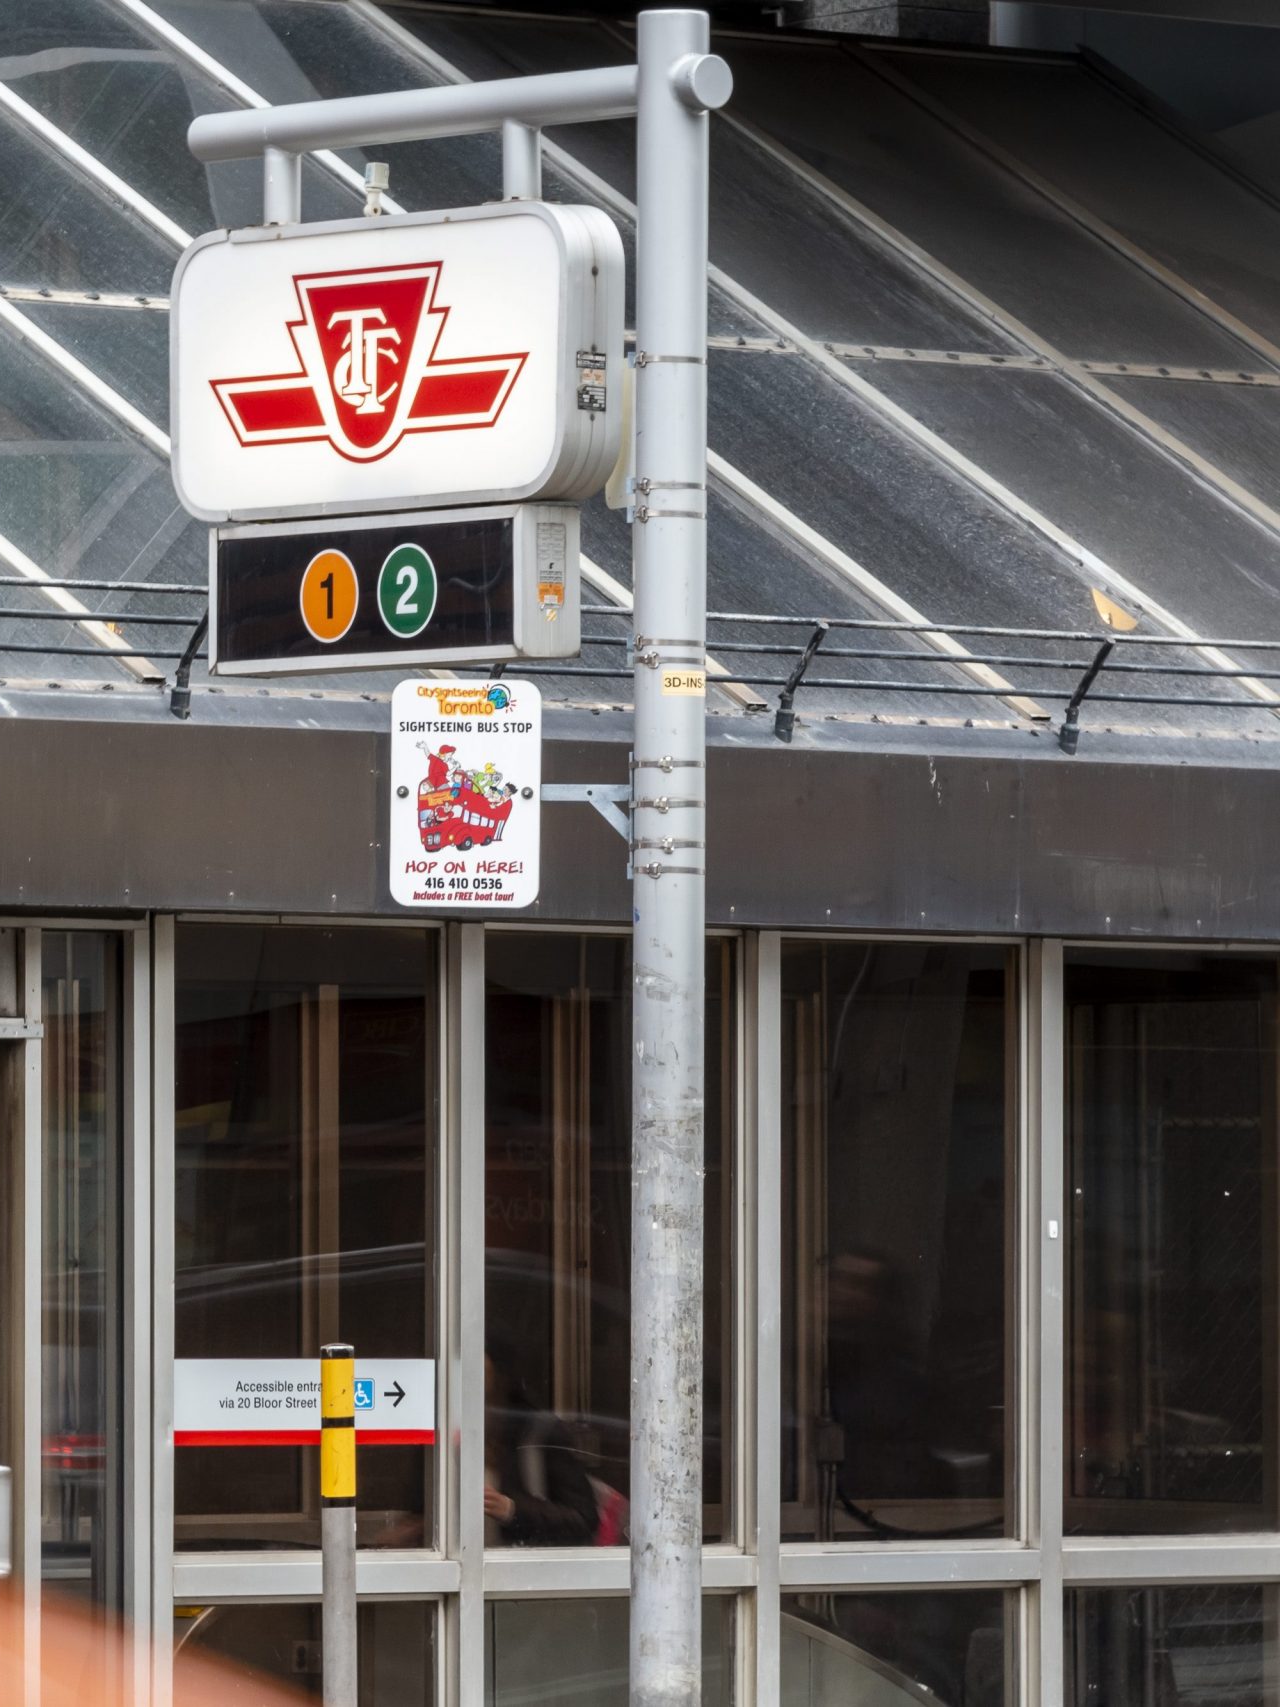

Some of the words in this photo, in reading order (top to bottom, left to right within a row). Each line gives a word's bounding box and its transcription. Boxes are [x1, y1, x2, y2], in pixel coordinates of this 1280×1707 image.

[326, 307, 402, 415] TTC
[320, 572, 334, 620] 1
[395, 565, 419, 615] 2
[439, 699, 494, 714] Toronto
[399, 721, 472, 733] SIGHTSEEING
[477, 722, 499, 733] BUS
[503, 722, 532, 733] STOP
[405, 860, 438, 874] HOP
[443, 861, 466, 874] ON
[476, 861, 523, 874] HERE!
[424, 877, 445, 889] 416
[448, 878, 469, 889] 410
[472, 878, 503, 890] 0536
[413, 891, 446, 901] Includes
[454, 892, 473, 901] FREE
[474, 892, 493, 901] boat
[494, 892, 515, 902] tour!
[235, 1380, 294, 1392] Accessible
[219, 1397, 235, 1409] via
[237, 1397, 251, 1409] 20
[253, 1397, 282, 1409] Bloor
[285, 1397, 317, 1409] Street
